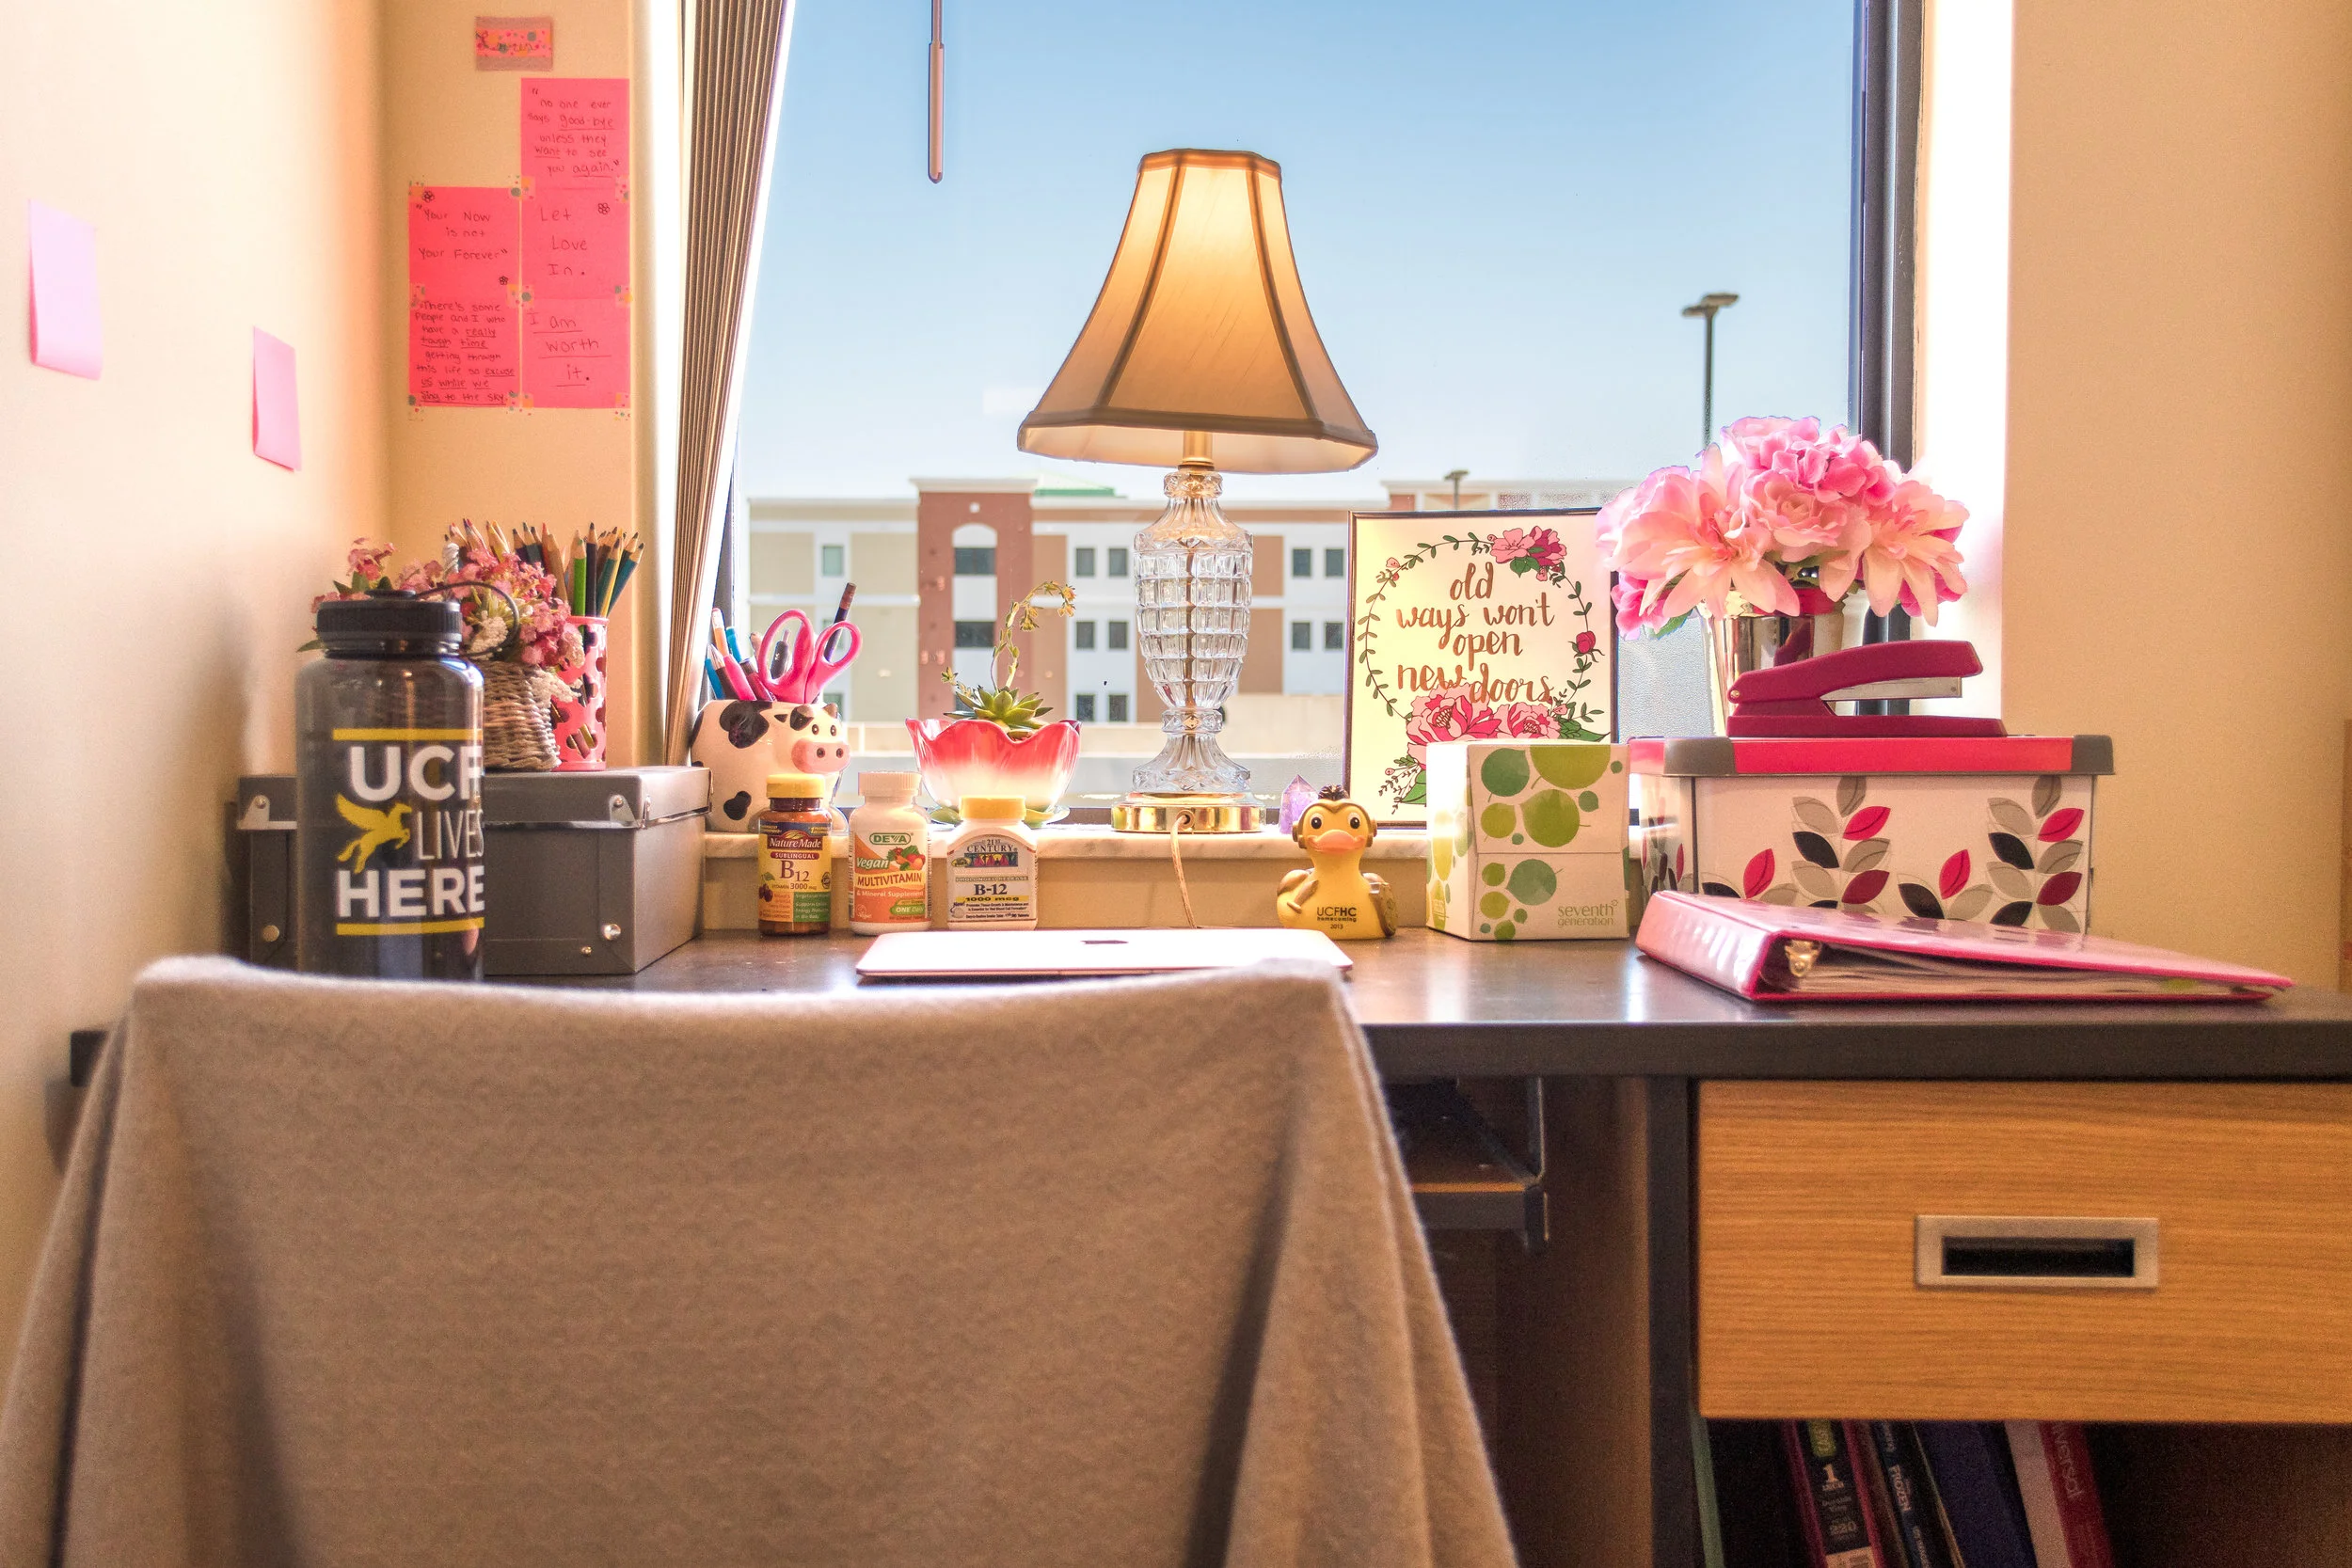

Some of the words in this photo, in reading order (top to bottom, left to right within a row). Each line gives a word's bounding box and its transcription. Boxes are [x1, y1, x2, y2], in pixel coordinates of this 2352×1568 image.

[559, 101, 579, 109] one
[590, 101, 612, 109] ever
[539, 134, 575, 144] unless
[582, 135, 608, 148] they
[534, 146, 561, 156] want
[566, 149, 578, 157] to
[589, 150, 608, 158] see
[547, 165, 565, 177] you
[540, 207, 572, 222] Let
[446, 227, 458, 238] is
[551, 235, 588, 251] Love
[419, 247, 445, 261] Your
[471, 304, 501, 312] some
[451, 314, 469, 323] and
[471, 314, 480, 323] I
[527, 311, 539, 325] I
[549, 316, 577, 329] am
[421, 325, 444, 334] have
[466, 328, 497, 338] really
[461, 338, 487, 348] time
[416, 364, 437, 373] this
[445, 366, 461, 374] life
[438, 378, 467, 388] while
[1450, 562, 1494, 601] old
[1395, 603, 1470, 650] ways
[1483, 592, 1555, 627] won't
[1452, 630, 1524, 672] open
[1397, 663, 1467, 692] new
[1469, 662, 1555, 705] doors
[349, 745, 484, 801] UCF
[417, 809, 485, 861] LIVES
[856, 857, 890, 870] Vegan
[857, 872, 922, 886] MULTIVITAMIN
[338, 865, 486, 918] HERE
[974, 883, 1008, 895] B-12
[1317, 907, 1357, 916] UCFHC
[1558, 904, 1613, 917] seventh
[1558, 917, 1613, 928] generation
[1887, 1464, 1913, 1513] FROZEN
